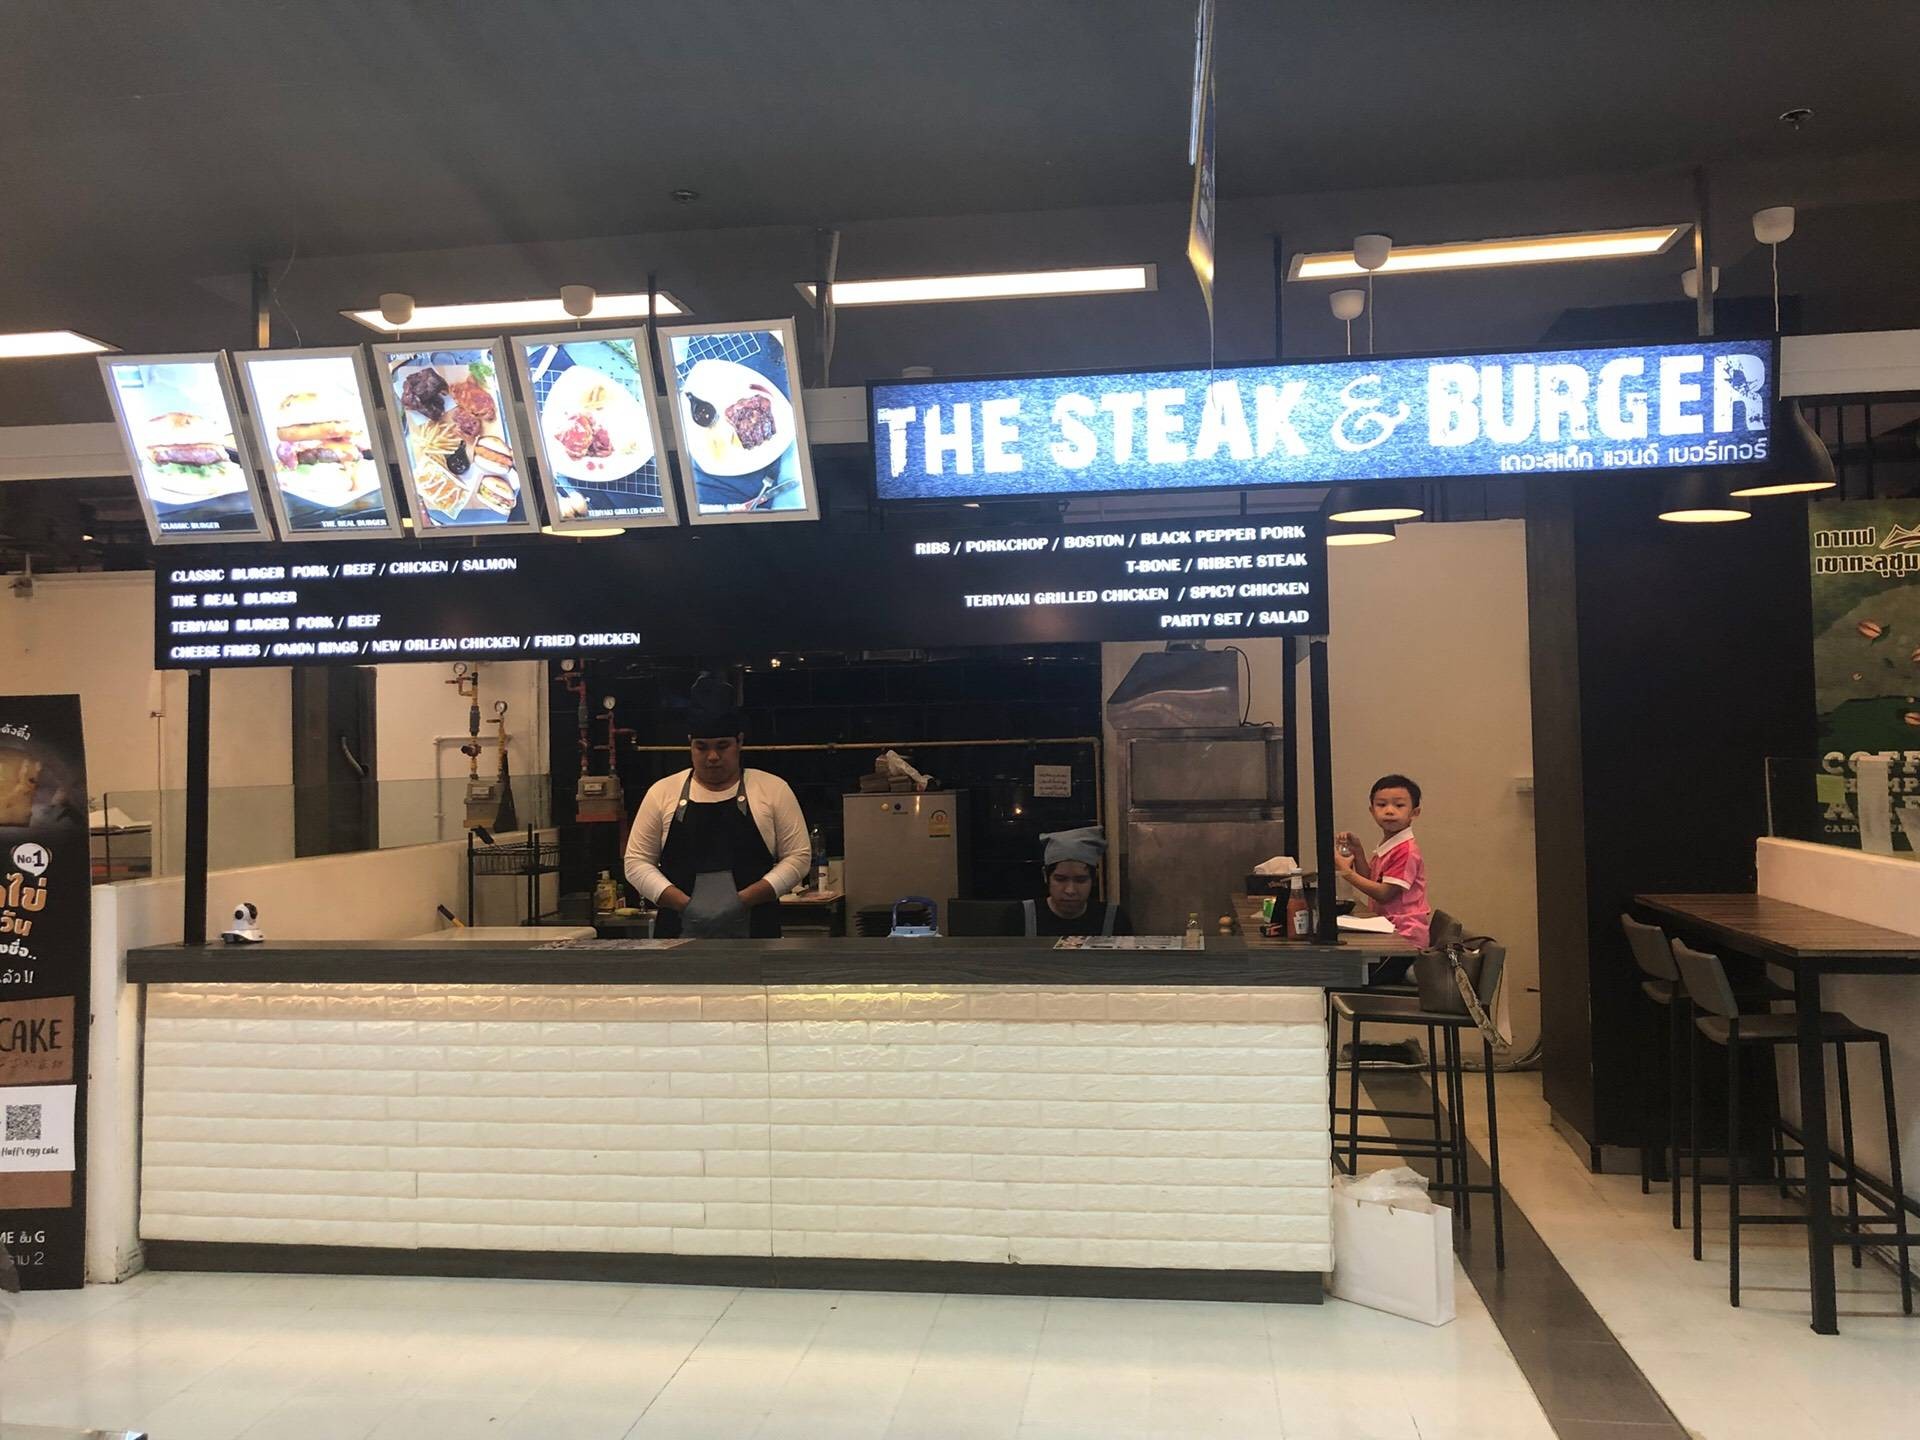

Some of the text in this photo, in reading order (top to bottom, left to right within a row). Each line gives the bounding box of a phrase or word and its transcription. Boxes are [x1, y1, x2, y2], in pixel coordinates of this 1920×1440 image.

[877, 353, 1767, 478] THE STEAK & BURGER
[1501, 437, 1768, 472] เดอะสเต็ก แอนด์ เบอร์เกอร์
[614, 507, 639, 516] GRILLED
[639, 506, 665, 514] CHICKEN
[915, 541, 951, 556] RIBS
[966, 537, 1049, 554] PORKCHOP
[1064, 533, 1125, 550] BOSTON
[1140, 530, 1192, 546] BLACK
[1195, 527, 1257, 543] PEPPER
[1261, 525, 1306, 540] PORK
[1814, 526, 1876, 548] กาแฟ
[171, 568, 225, 583] CLASSIC
[230, 566, 285, 581] BURGER
[291, 564, 330, 579] PORK
[342, 562, 377, 577] BEEF
[389, 560, 449, 575] CHICKEN
[462, 557, 517, 572] SALMON
[1126, 558, 1182, 574] T-BONE
[1196, 555, 1254, 571] RIBEYE
[1256, 552, 1308, 568] STEAK
[171, 590, 298, 608] THE REAL BURGER
[964, 592, 1031, 608] TERIYAKI
[1033, 590, 1098, 606] GRILLED
[1100, 587, 1169, 603] CHICKEN
[1189, 584, 1236, 600] SPICY
[1238, 581, 1310, 598] CHICKEN
[170, 619, 230, 634] TERIYAKI
[235, 617, 290, 632] BURGER
[295, 615, 335, 630] PORK
[346, 614, 381, 628] BEEF
[1160, 613, 1212, 628] PARTY
[1213, 612, 1244, 626] SET
[1258, 609, 1310, 625] SALAD
[170, 645, 221, 659] CHEESE
[222, 643, 261, 657] FRIES
[272, 642, 316, 656] ONION
[317, 640, 359, 655] RINGS
[371, 639, 402, 653] NEW
[403, 638, 458, 652] ORLEAN
[459, 636, 520, 650] CHICKEN
[534, 634, 576, 648] FRIED
[578, 632, 641, 646] CHICKEN
[0, 1018, 63, 1054] CAKE
[26, 1147, 41, 1158] egg
[42, 1146, 60, 1156] cake
[34, 1230, 46, 1244] G
[33, 1251, 45, 1266] 2
